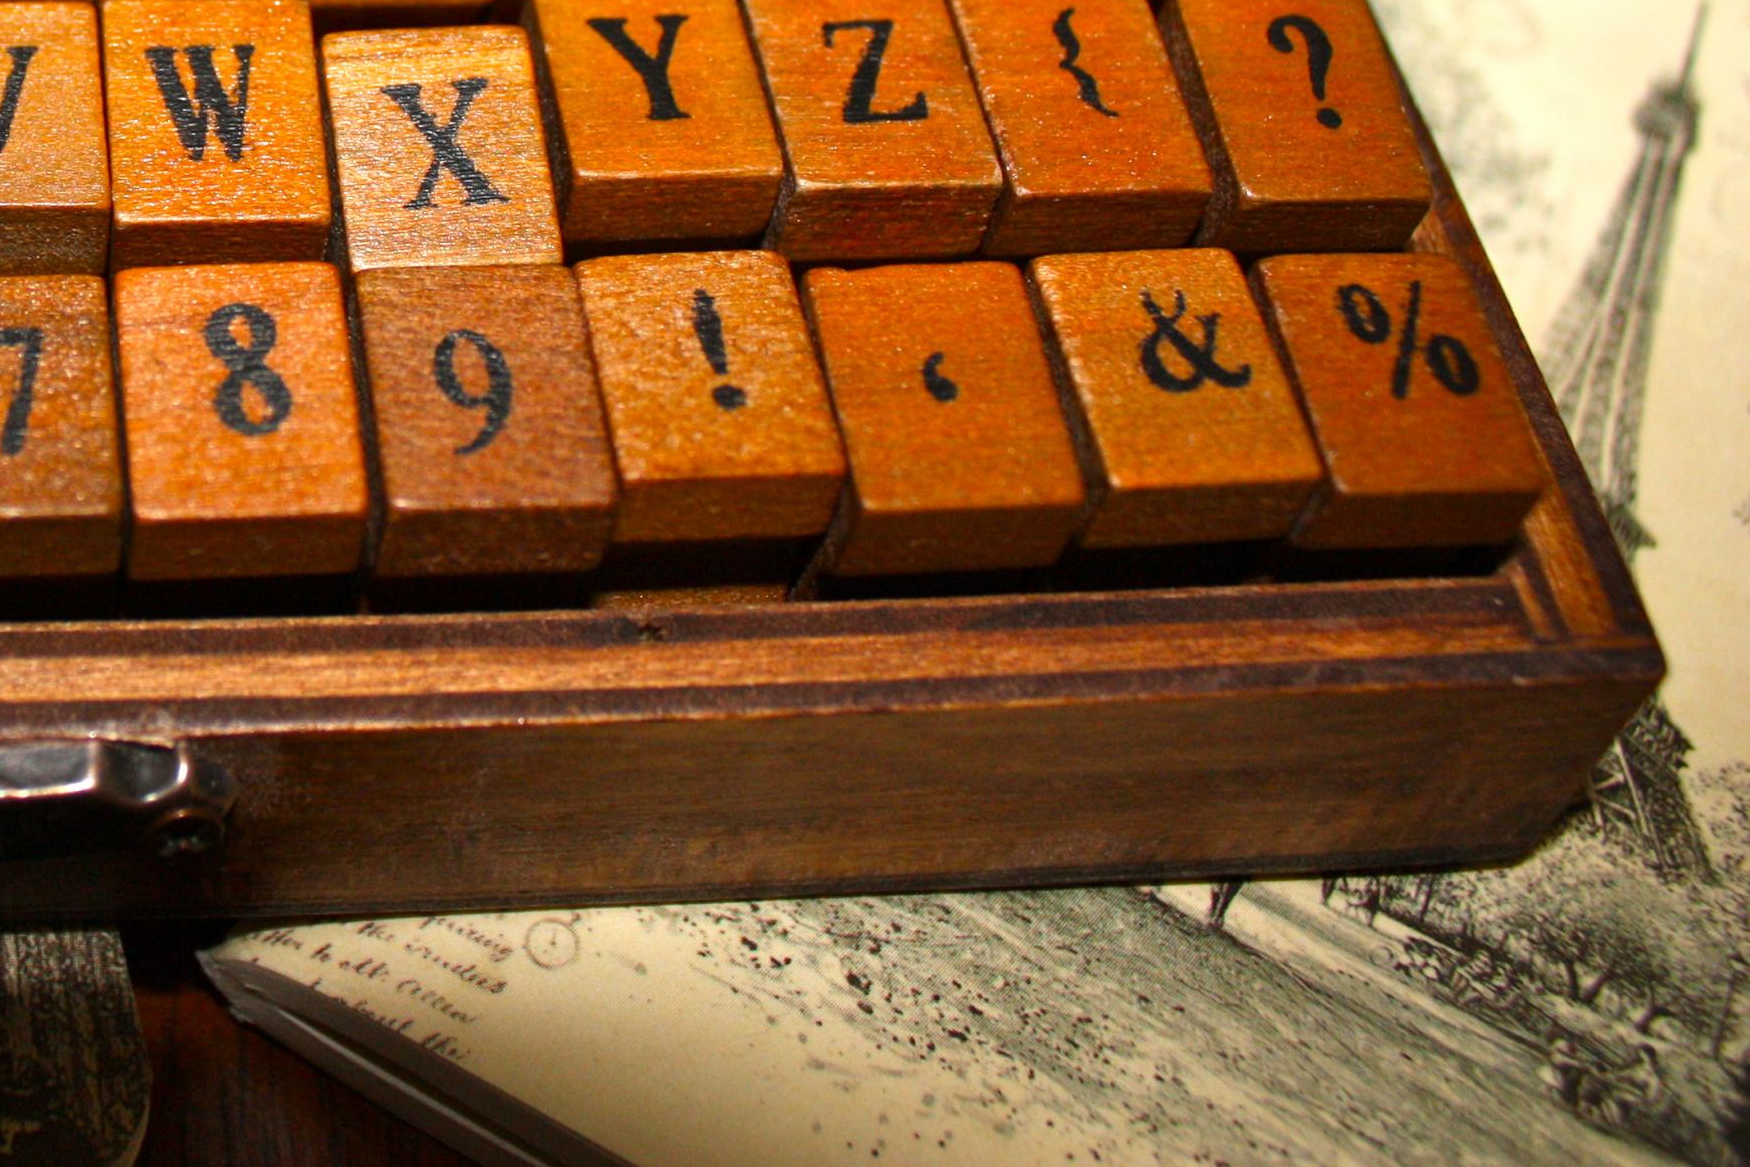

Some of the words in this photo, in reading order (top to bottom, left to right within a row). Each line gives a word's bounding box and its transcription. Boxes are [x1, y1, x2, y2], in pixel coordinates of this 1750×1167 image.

[145, 44, 256, 163] W
[380, 77, 511, 211] X
[587, 14, 691, 122] Y
[822, 19, 929, 125] Z
[1267, 14, 1343, 130] ?
[201, 302, 294, 437] 8
[433, 328, 514, 456] 9
[691, 289, 747, 412] !
[1138, 288, 1252, 394] &
[1337, 280, 1481, 400] %
